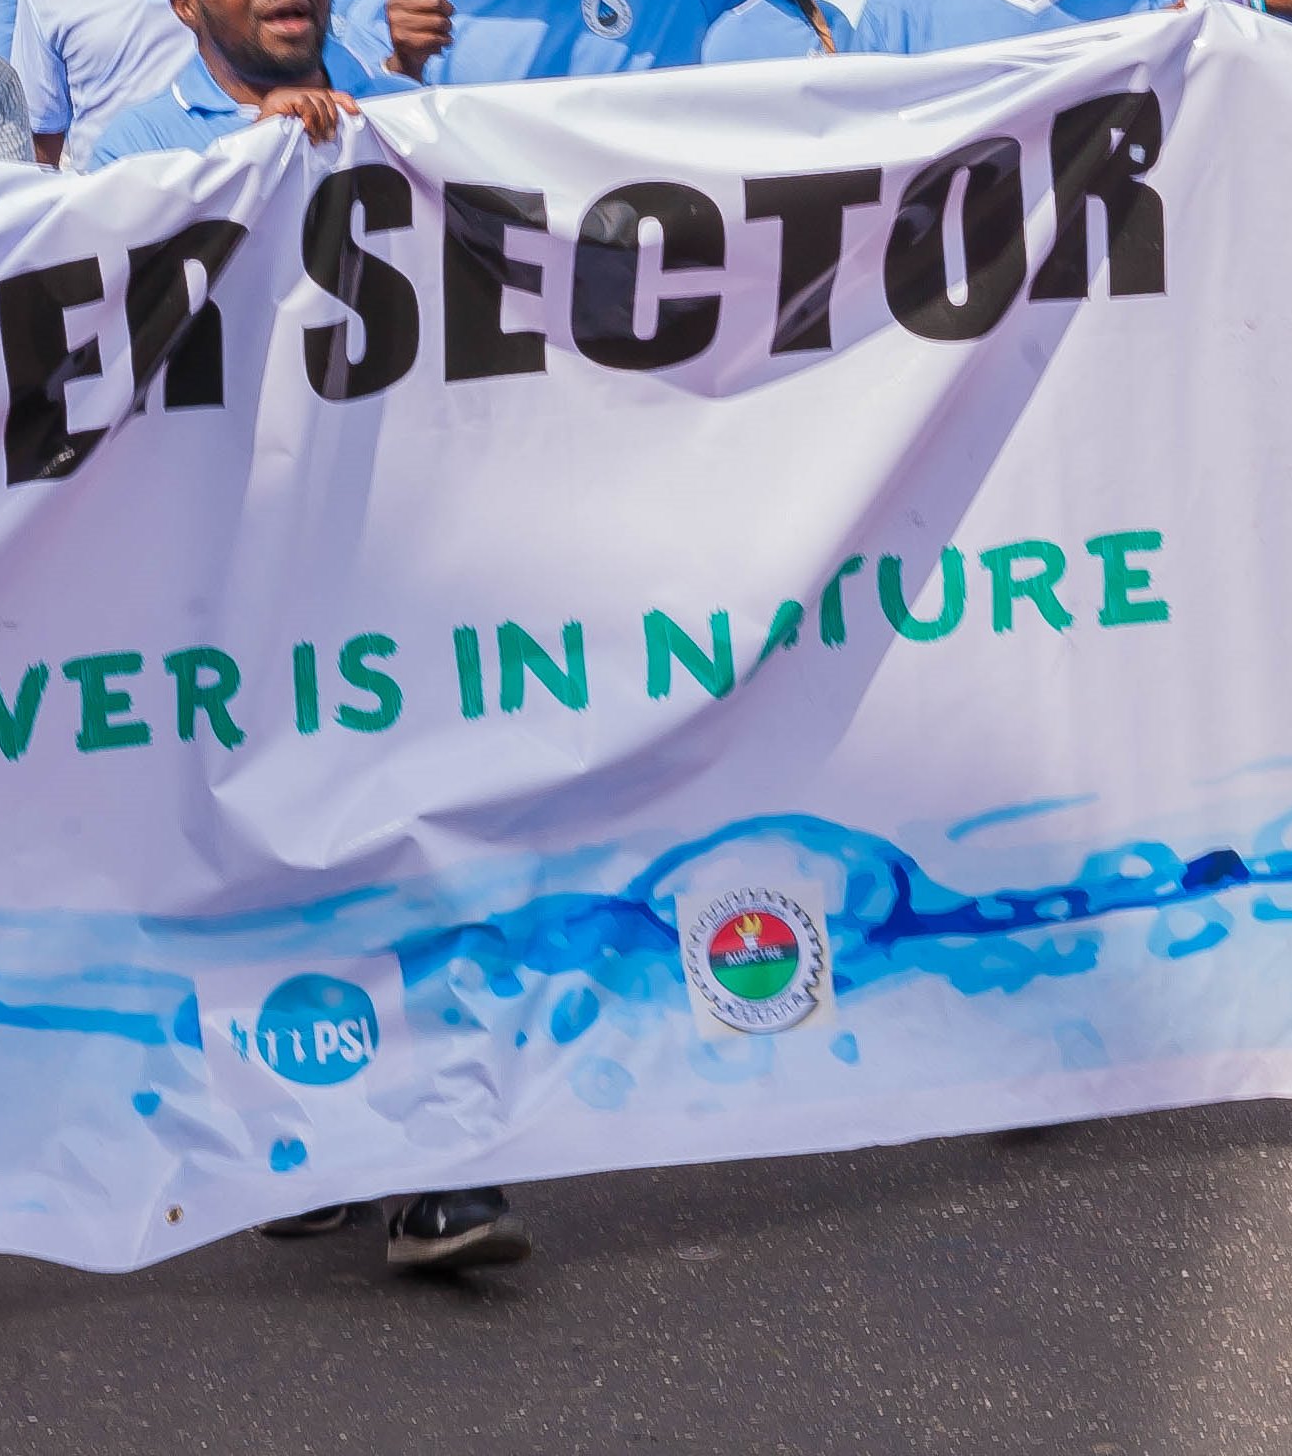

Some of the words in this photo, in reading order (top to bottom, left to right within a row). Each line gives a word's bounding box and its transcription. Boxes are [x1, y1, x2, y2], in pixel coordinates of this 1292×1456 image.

[301, 89, 1168, 402] SECTOR
[292, 632, 404, 736] IS
[452, 620, 590, 720] IN
[312, 1016, 375, 1067] PSI
